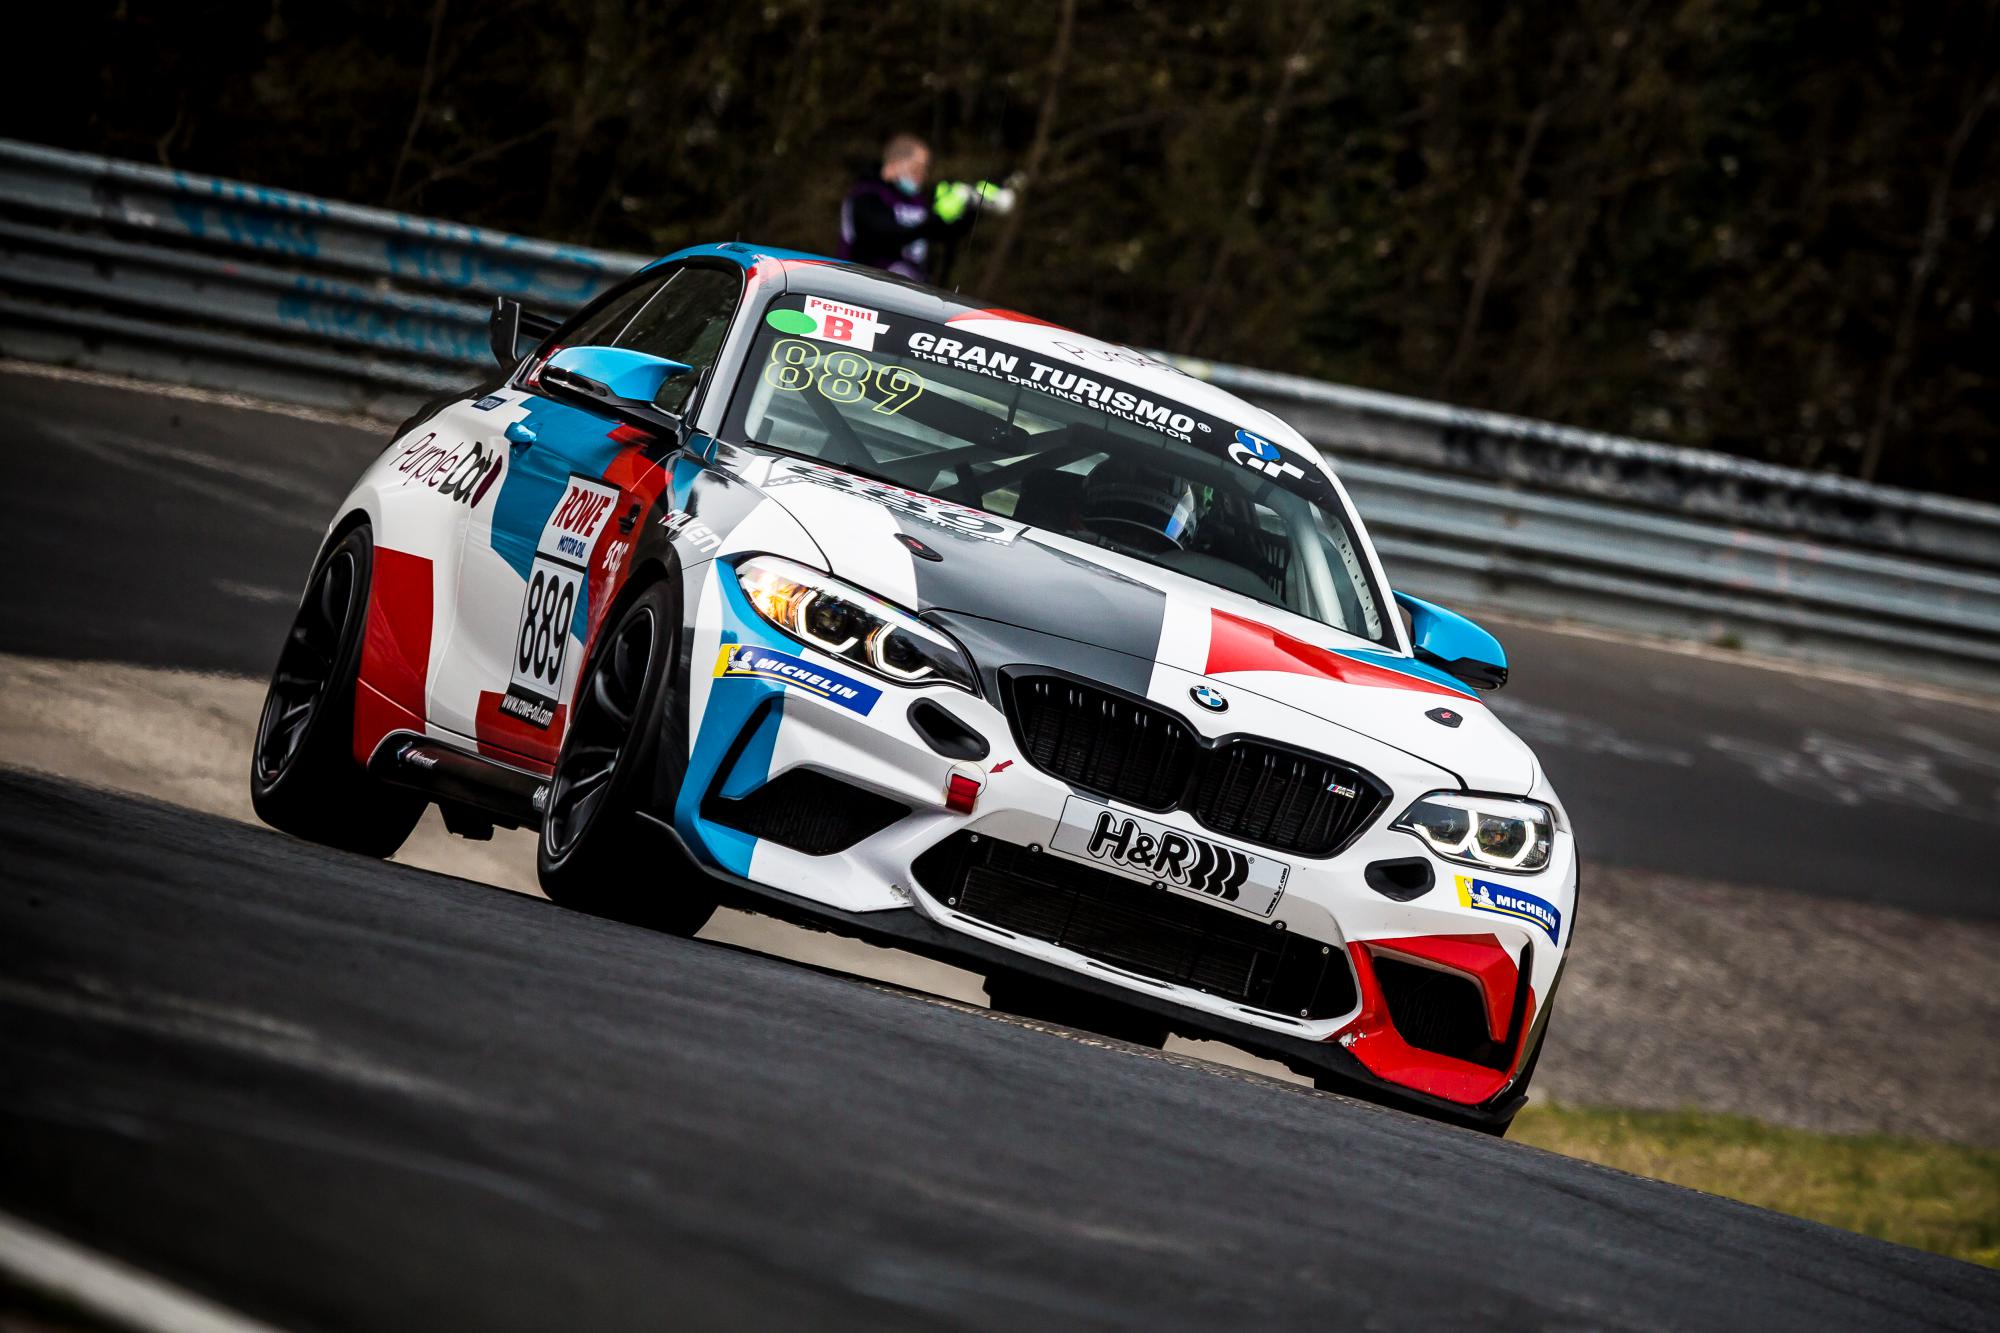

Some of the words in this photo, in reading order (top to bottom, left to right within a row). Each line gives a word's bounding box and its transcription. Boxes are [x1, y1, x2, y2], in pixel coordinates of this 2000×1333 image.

[810, 299, 872, 321] Permit
[822, 314, 854, 341] B
[907, 332, 1019, 373] GRAN
[764, 338, 925, 416] 889
[910, 349, 949, 365] THE
[954, 360, 1003, 379] REAL
[1006, 375, 1083, 404] DRIVING
[1087, 398, 1193, 444] SIMULATOR
[552, 485, 612, 538] ROWE
[556, 535, 578, 556] MOTOR
[574, 540, 588, 559] OIL
[518, 569, 575, 686] 889
[753, 657, 859, 700] MICHELIN
[501, 693, 554, 727] www.rowe-oil.com
[1087, 811, 1197, 885] H&R
[1496, 894, 1557, 929] MICHELIN
